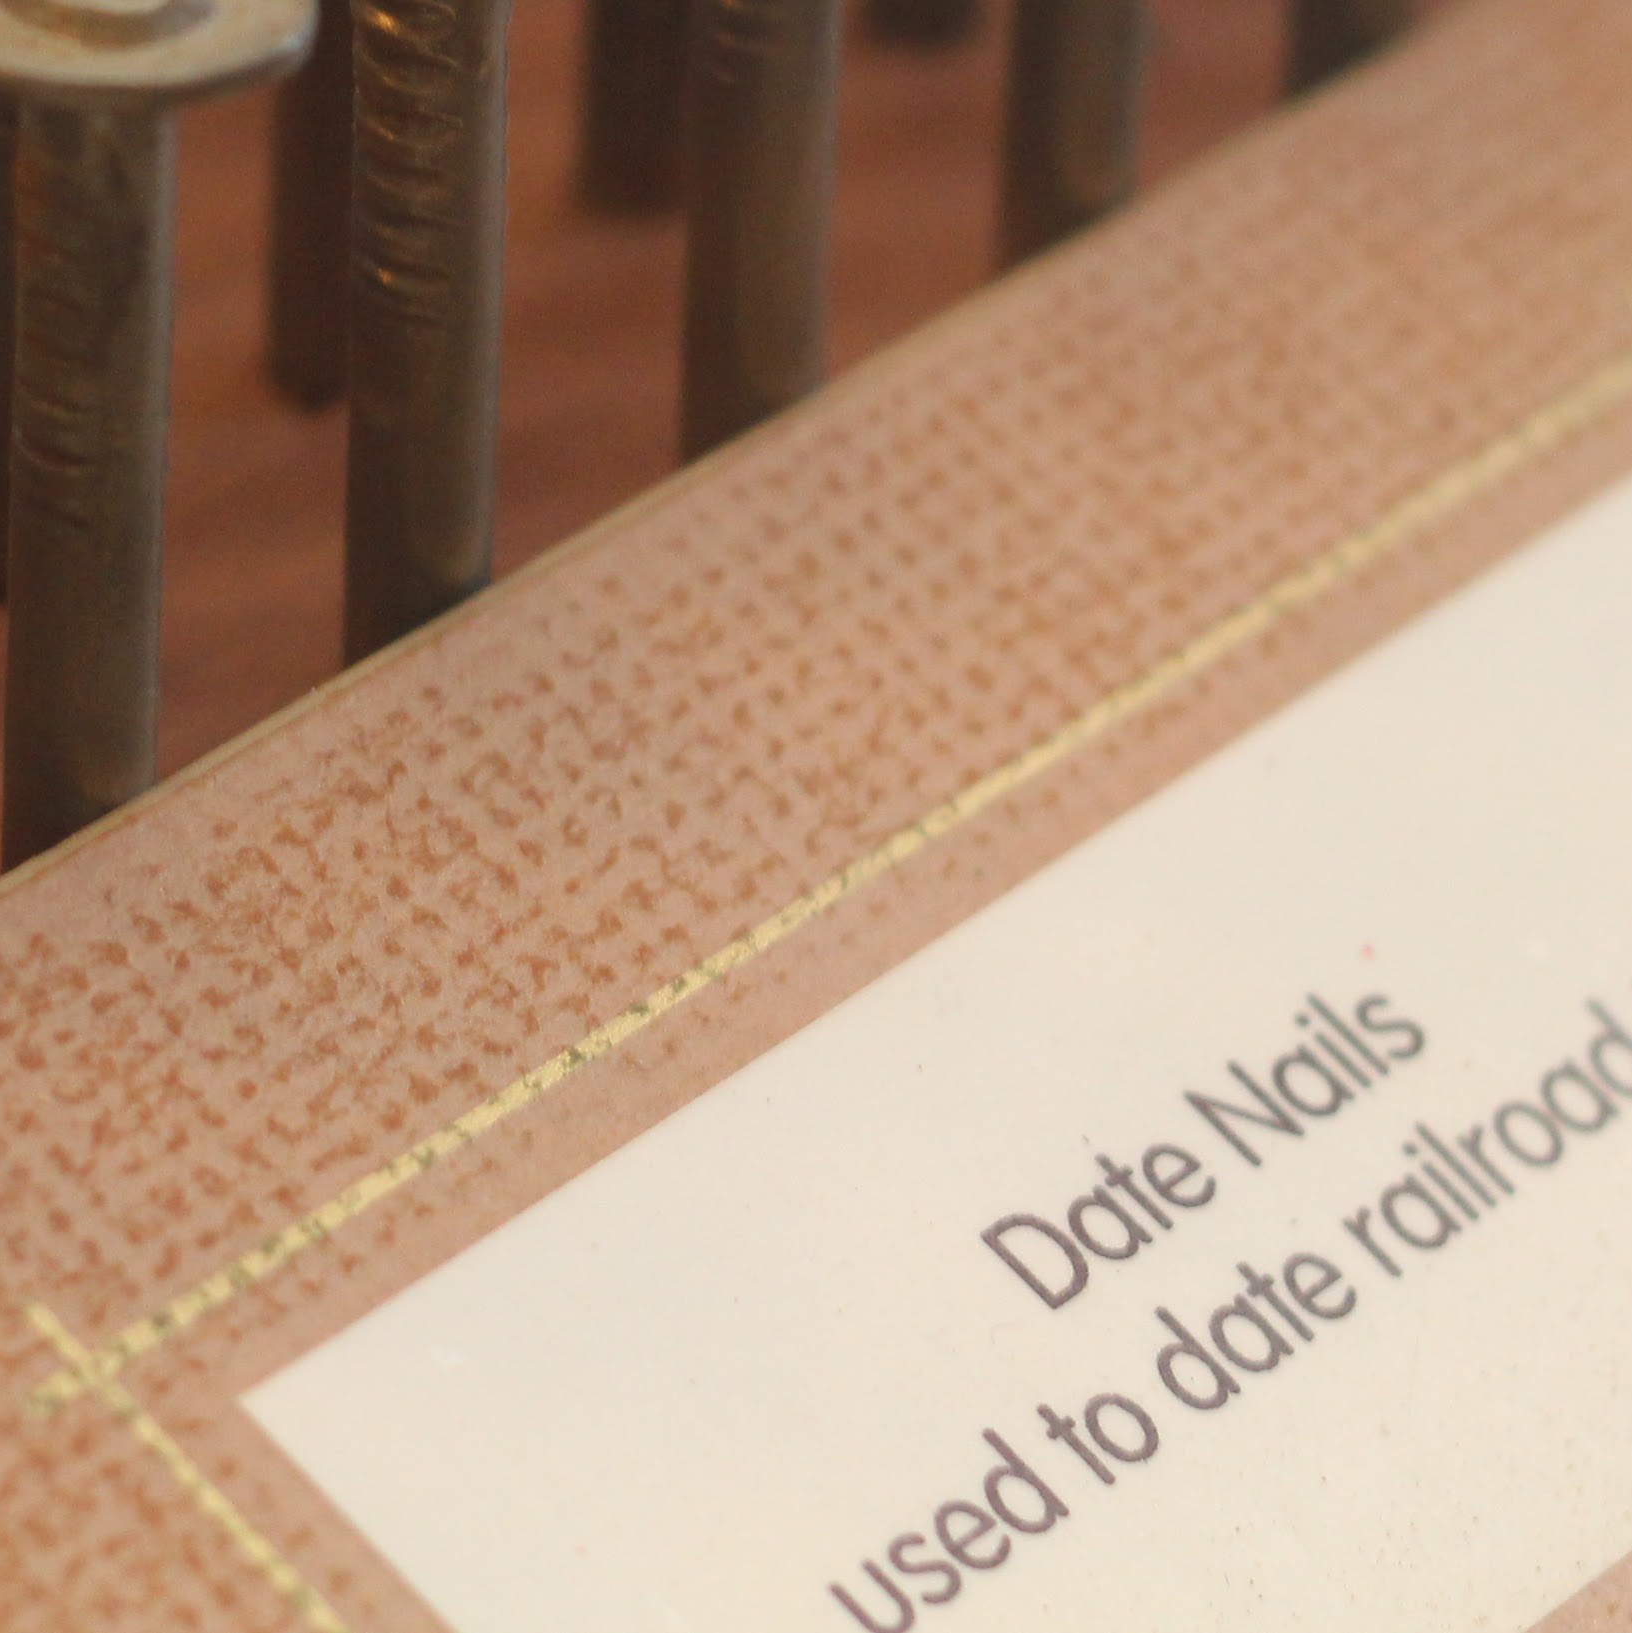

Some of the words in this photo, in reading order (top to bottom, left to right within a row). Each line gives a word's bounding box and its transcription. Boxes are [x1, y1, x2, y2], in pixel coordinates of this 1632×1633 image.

[979, 1143, 1217, 1312] Date
[1182, 993, 1428, 1169] Nails
[827, 1427, 1071, 1633] used
[1035, 1393, 1161, 1487] to
[1153, 1253, 1358, 1412] date
